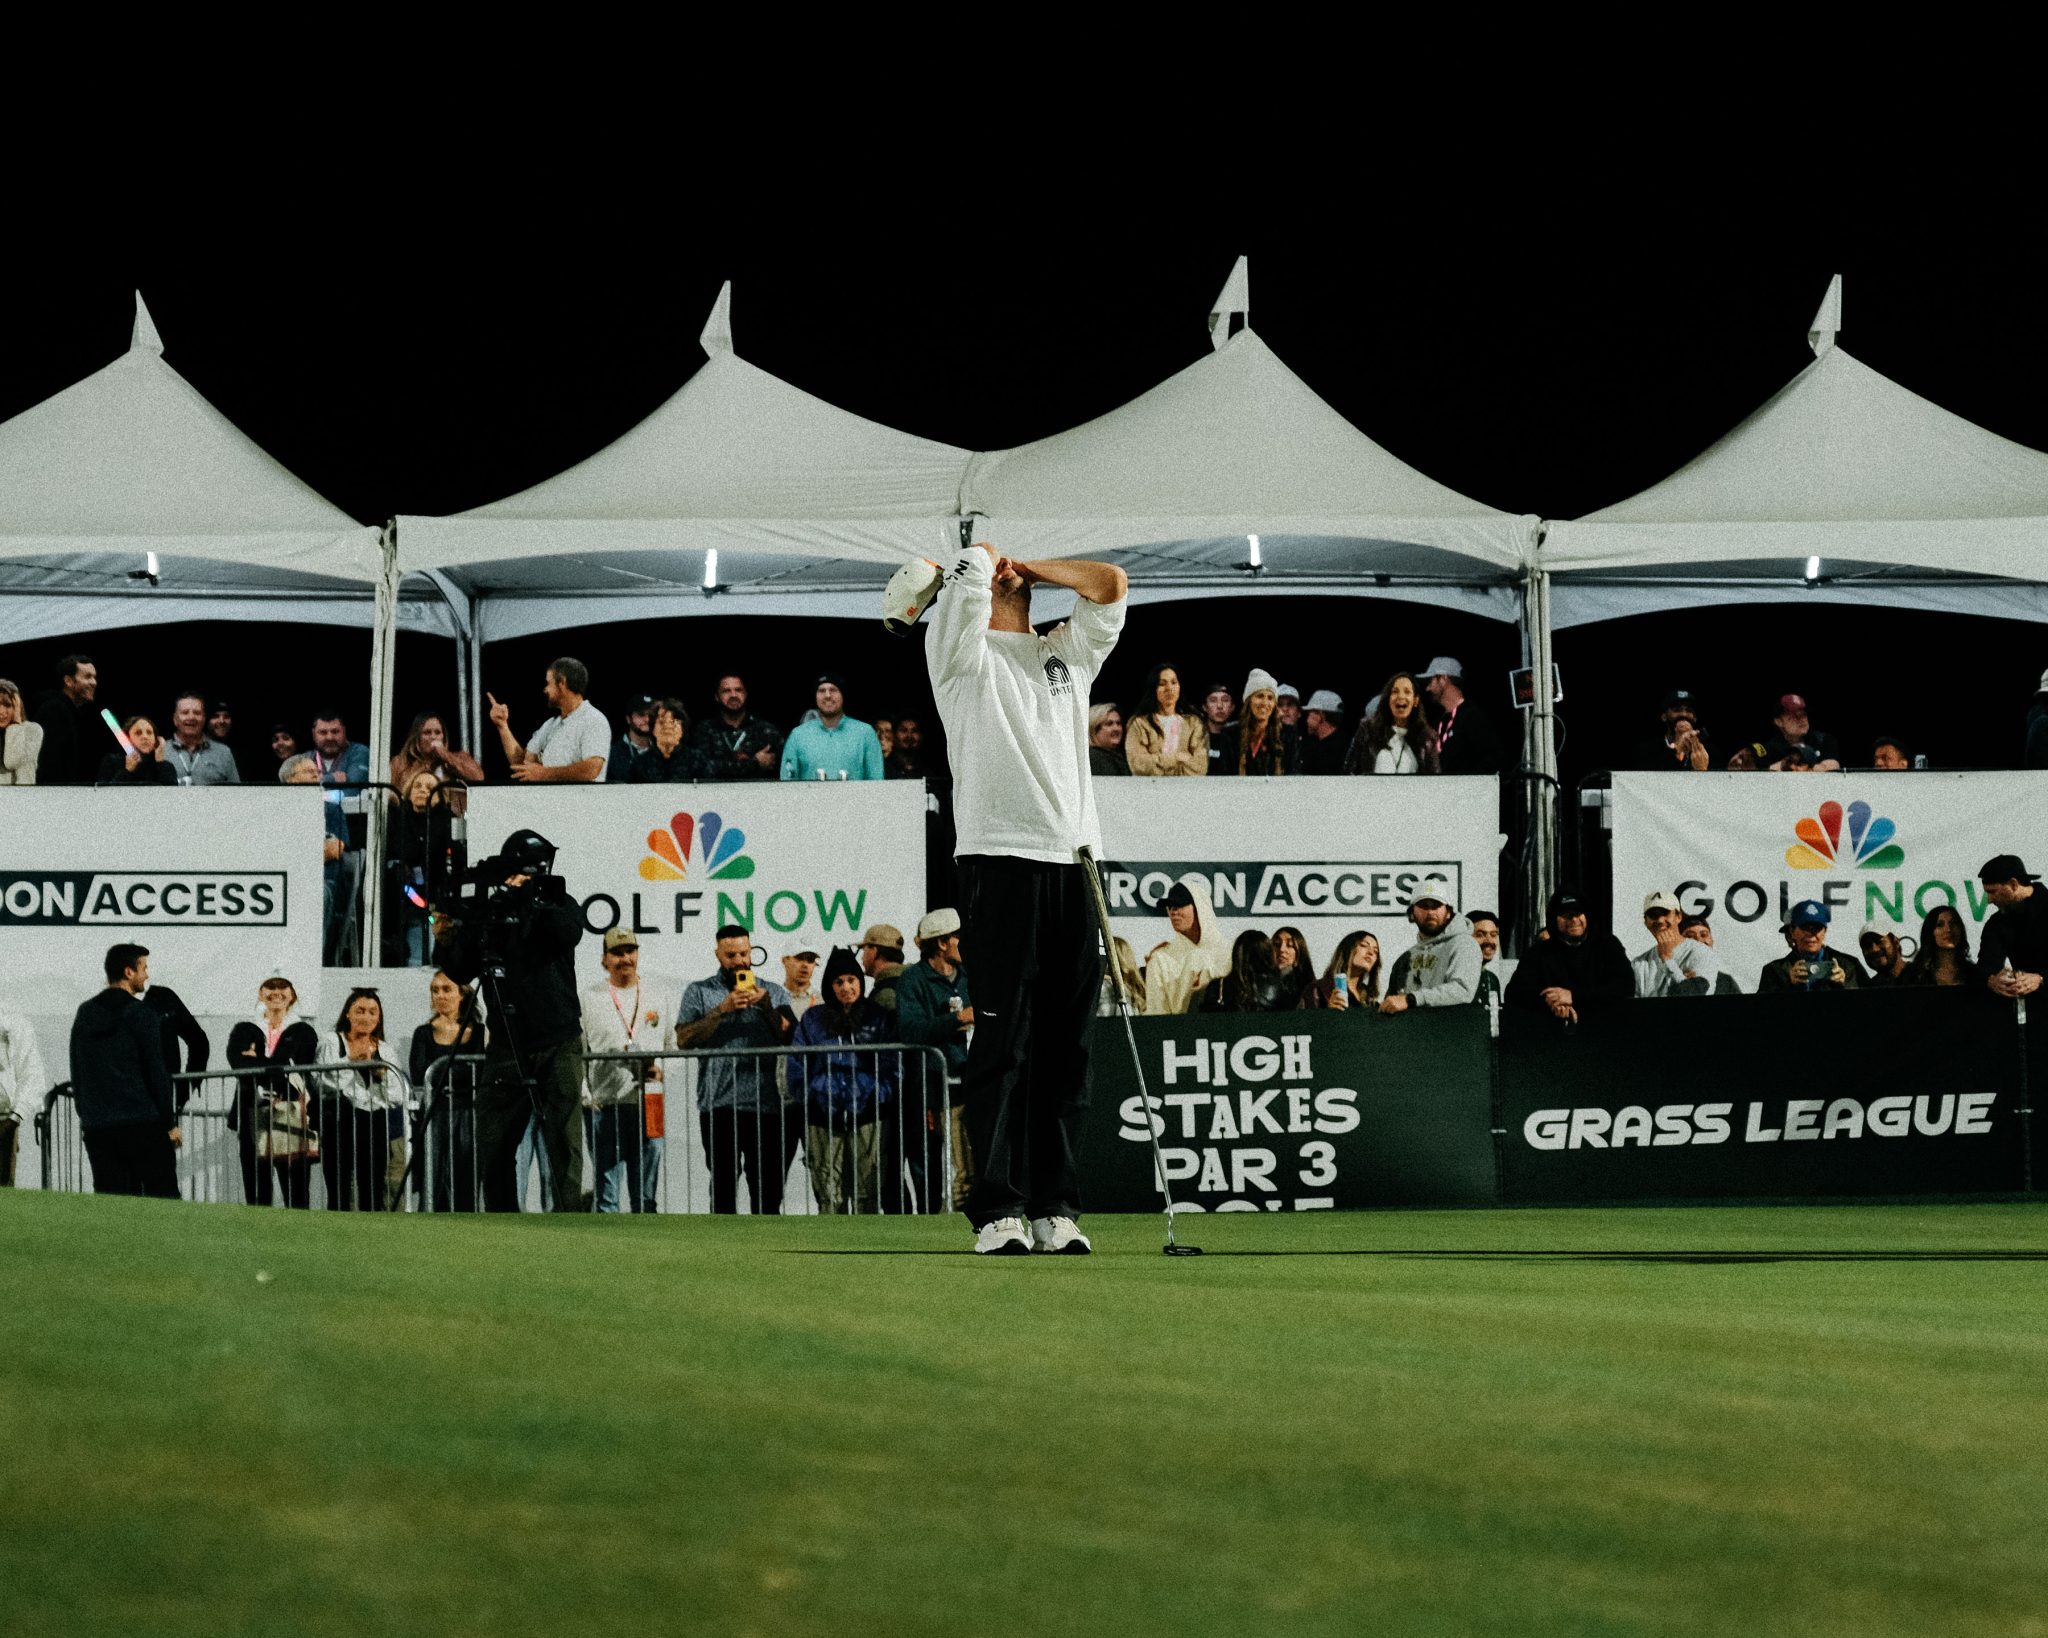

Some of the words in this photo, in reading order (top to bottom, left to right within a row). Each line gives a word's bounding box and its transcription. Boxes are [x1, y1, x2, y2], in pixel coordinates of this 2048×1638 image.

[0, 881, 75, 917] ON
[91, 883, 275, 916] ACCESS
[582, 889, 868, 935] OLFNOW
[1263, 873, 1448, 908] ACCES
[1162, 1035, 1313, 1086] HIGH
[1118, 1087, 1361, 1142] STAKES
[1523, 1104, 1734, 1150] GRASS
[1745, 1093, 1998, 1143] LEAGUE
[1155, 1147, 1278, 1193] PAR
[1299, 1141, 1338, 1187] 3
